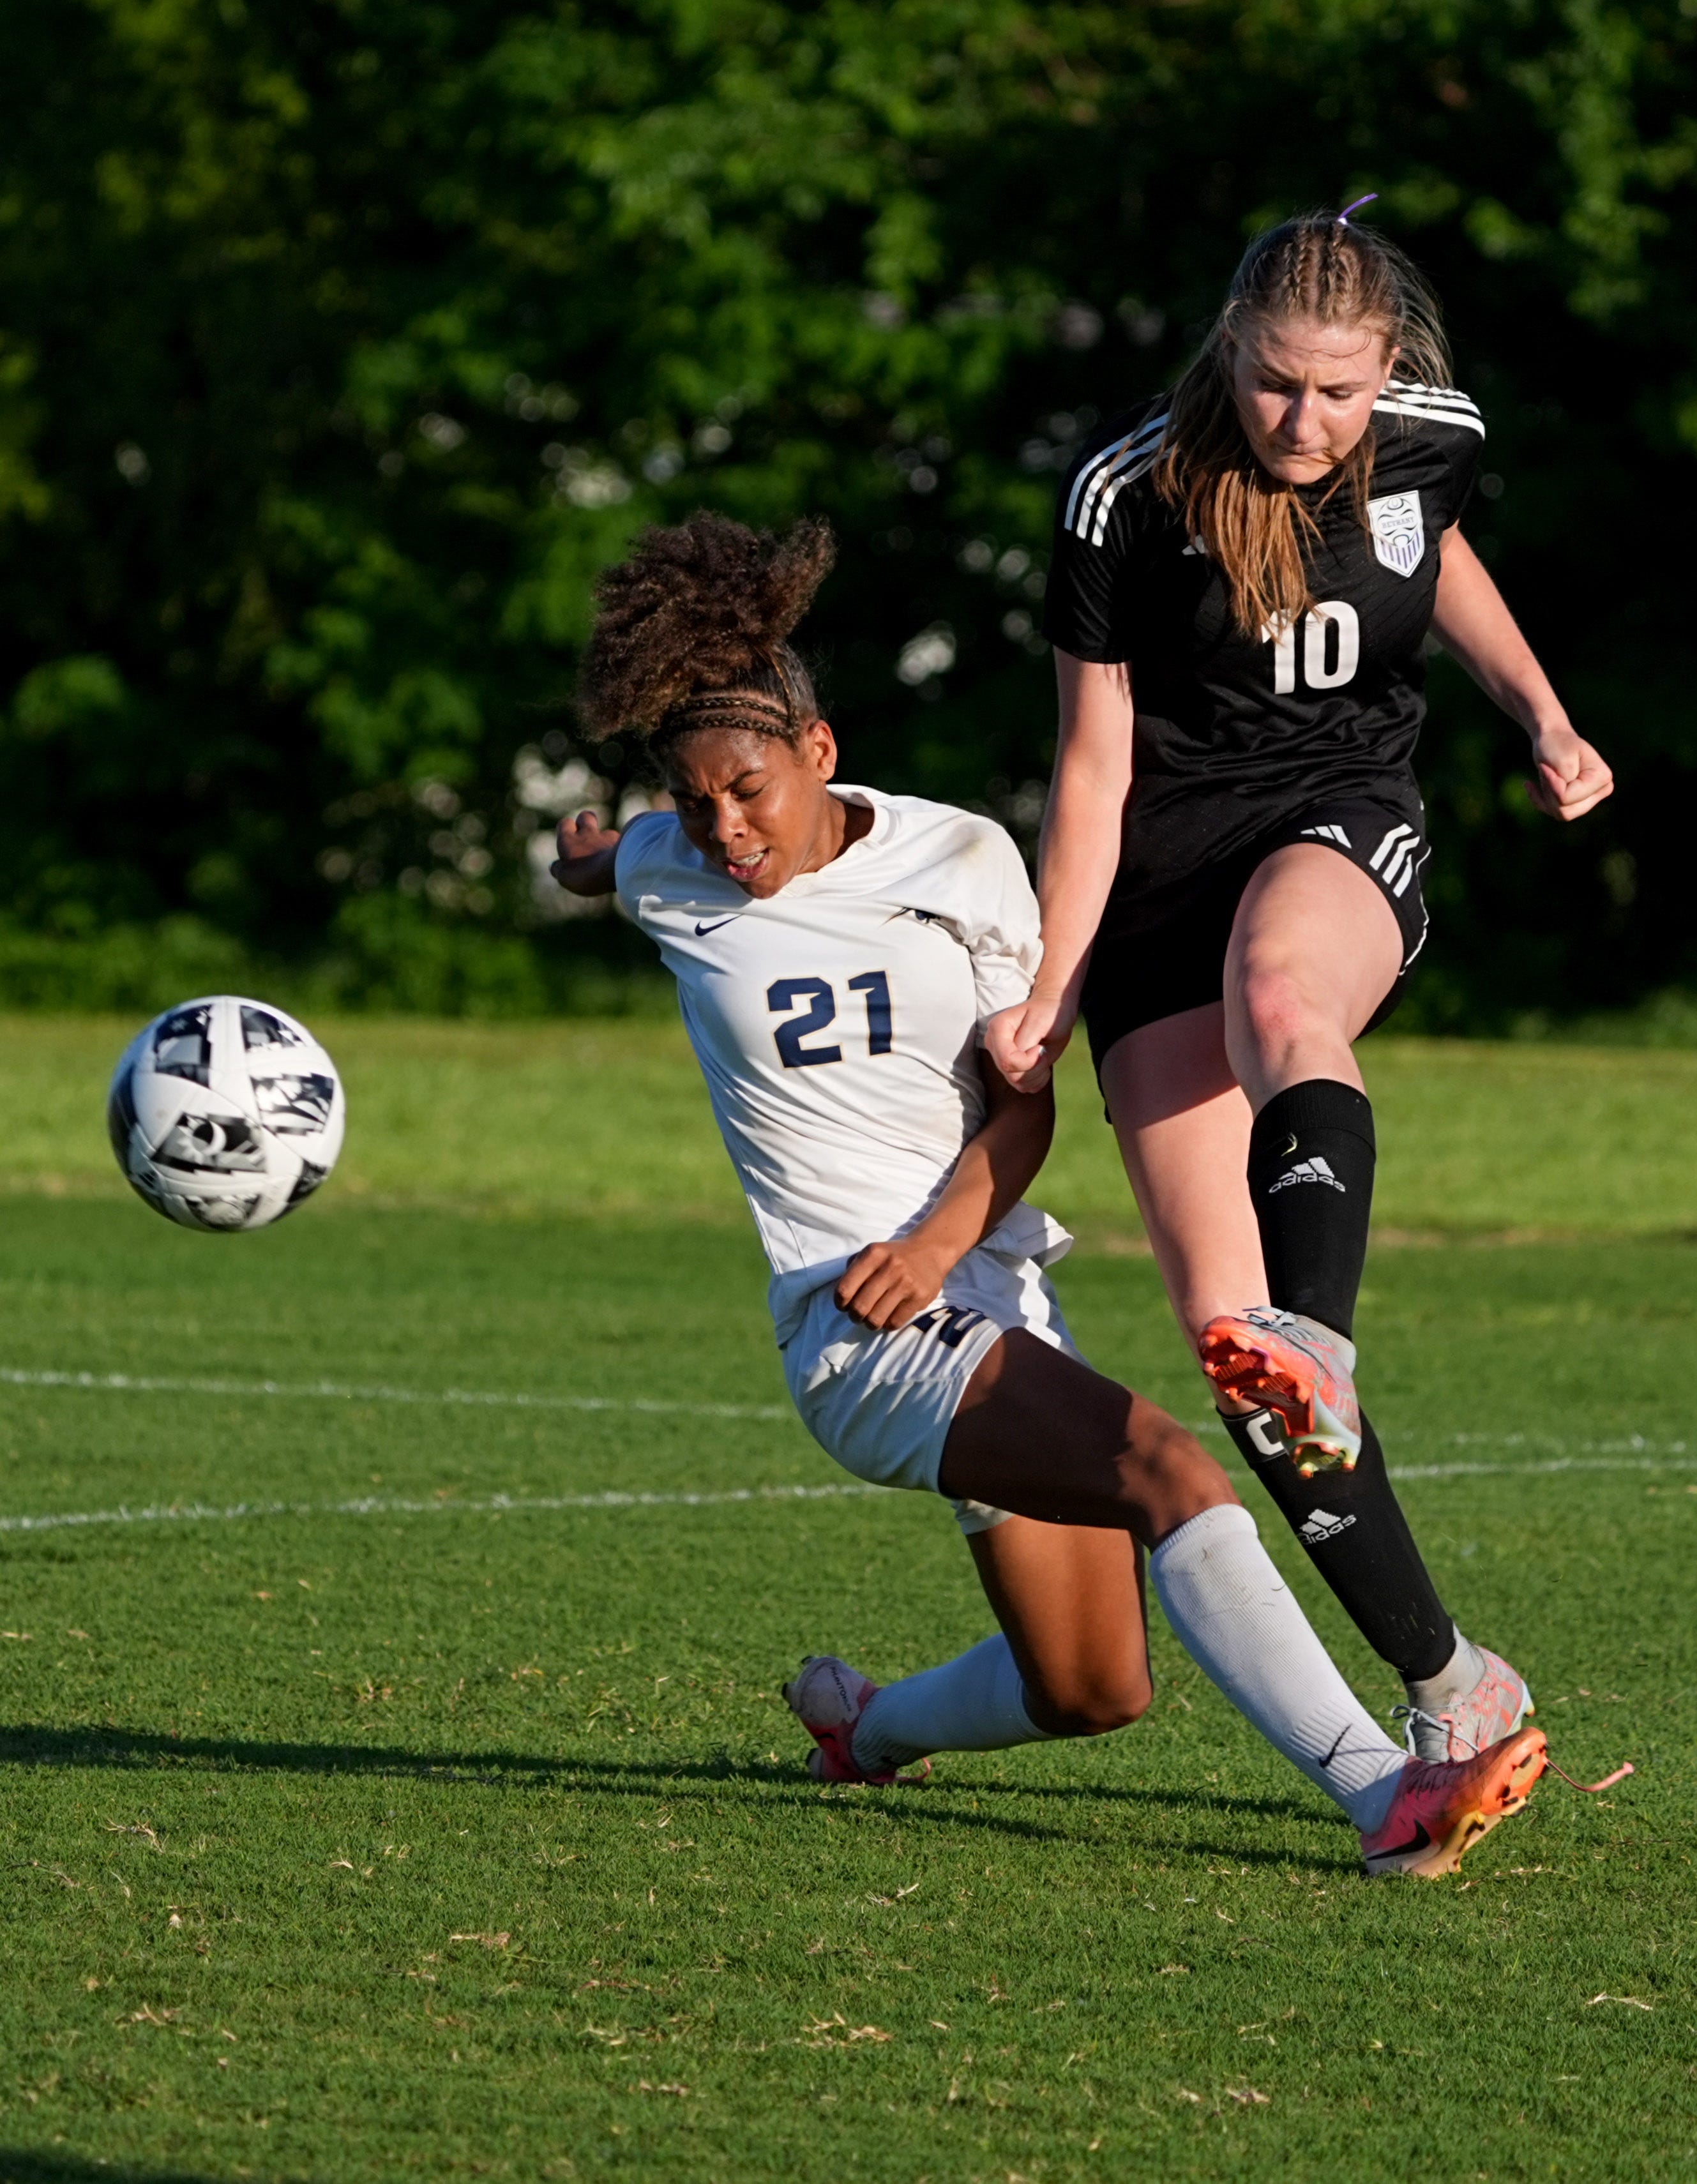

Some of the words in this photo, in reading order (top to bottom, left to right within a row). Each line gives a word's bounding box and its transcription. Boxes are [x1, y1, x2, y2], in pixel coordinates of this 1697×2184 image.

[1261, 600, 1359, 695] 10
[764, 967, 895, 1071] 21
[1268, 1171, 1346, 1193] adidas
[1297, 1514, 1357, 1545] didas
